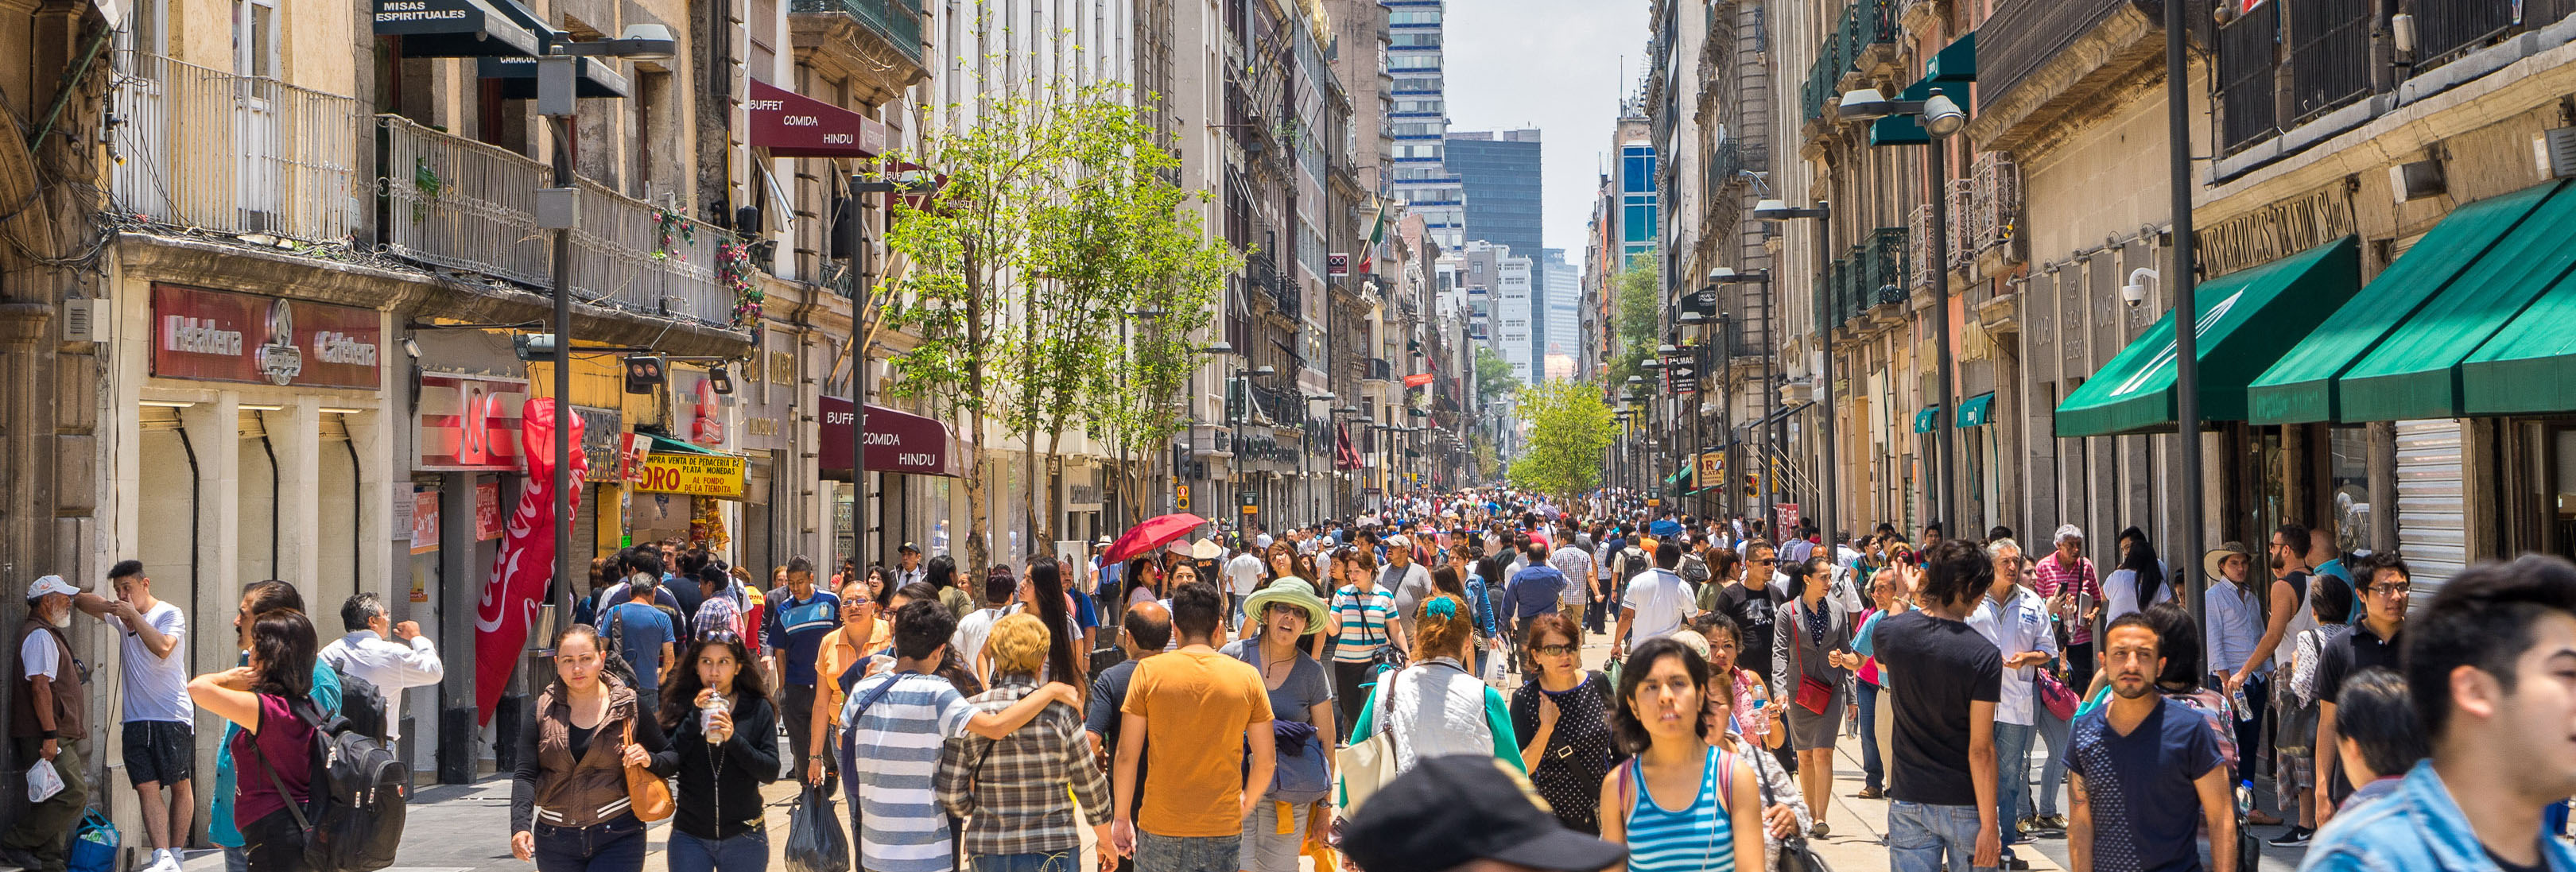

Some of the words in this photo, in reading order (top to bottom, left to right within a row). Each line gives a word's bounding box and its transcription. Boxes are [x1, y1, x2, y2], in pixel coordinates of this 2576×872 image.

[384, 2, 425, 11] MISAS
[375, 10, 466, 21] ESPIRITUALES
[750, 99, 783, 110] BUFFET
[783, 115, 818, 126] COMIDA
[824, 134, 853, 145] HINDU
[2289, 196, 2319, 251] LYON
[827, 411, 869, 426] BUFFT
[863, 432, 901, 446] COMIDA
[668, 456, 687, 465] VENTA
[699, 458, 730, 467] PEDACERIA
[898, 453, 936, 467] HINDU
[706, 467, 735, 475] MONEDAS
[639, 466, 680, 490] ORO
[704, 484, 731, 493] TIENDITA
[1779, 507, 1788, 525] RE
